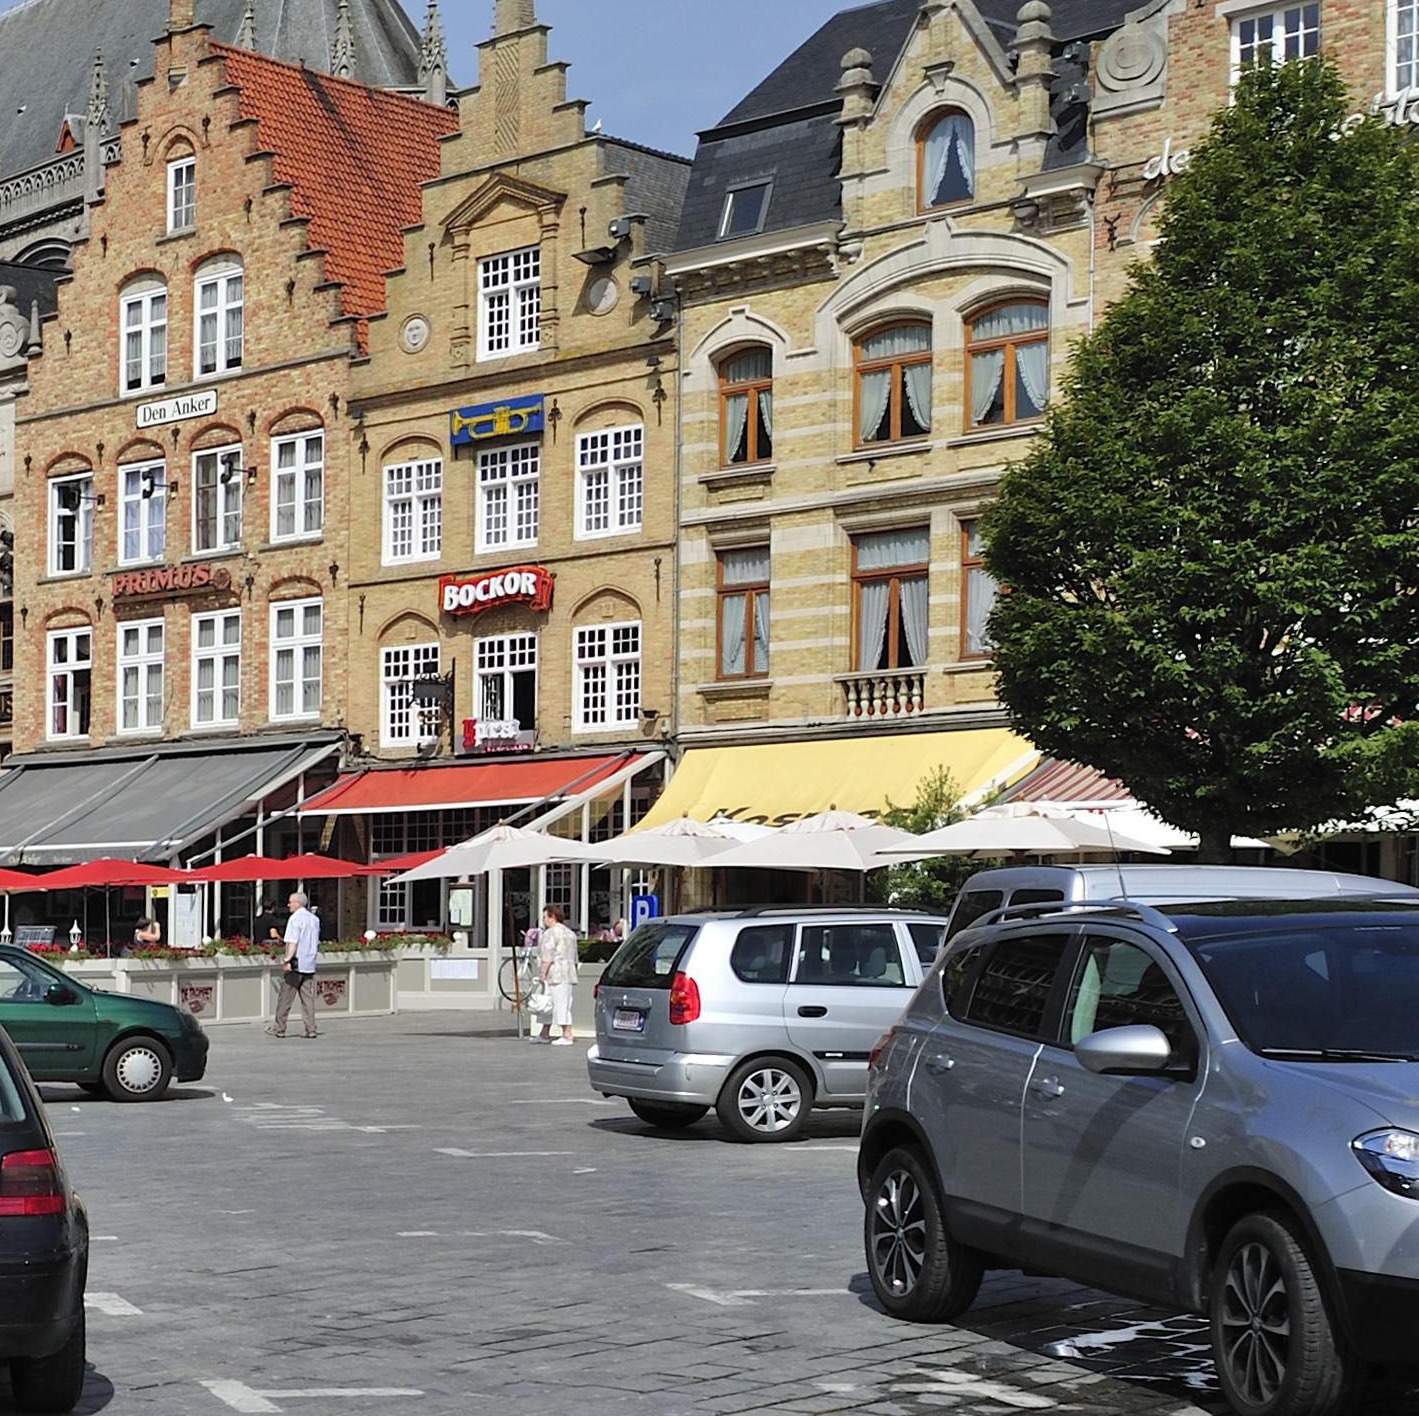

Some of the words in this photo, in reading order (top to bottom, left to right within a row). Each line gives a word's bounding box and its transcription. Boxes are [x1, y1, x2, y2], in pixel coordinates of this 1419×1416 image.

[143, 406, 167, 423] Den
[171, 397, 211, 417] Anker
[111, 563, 212, 597] PRIMUS
[443, 571, 538, 611] BOCKOR
